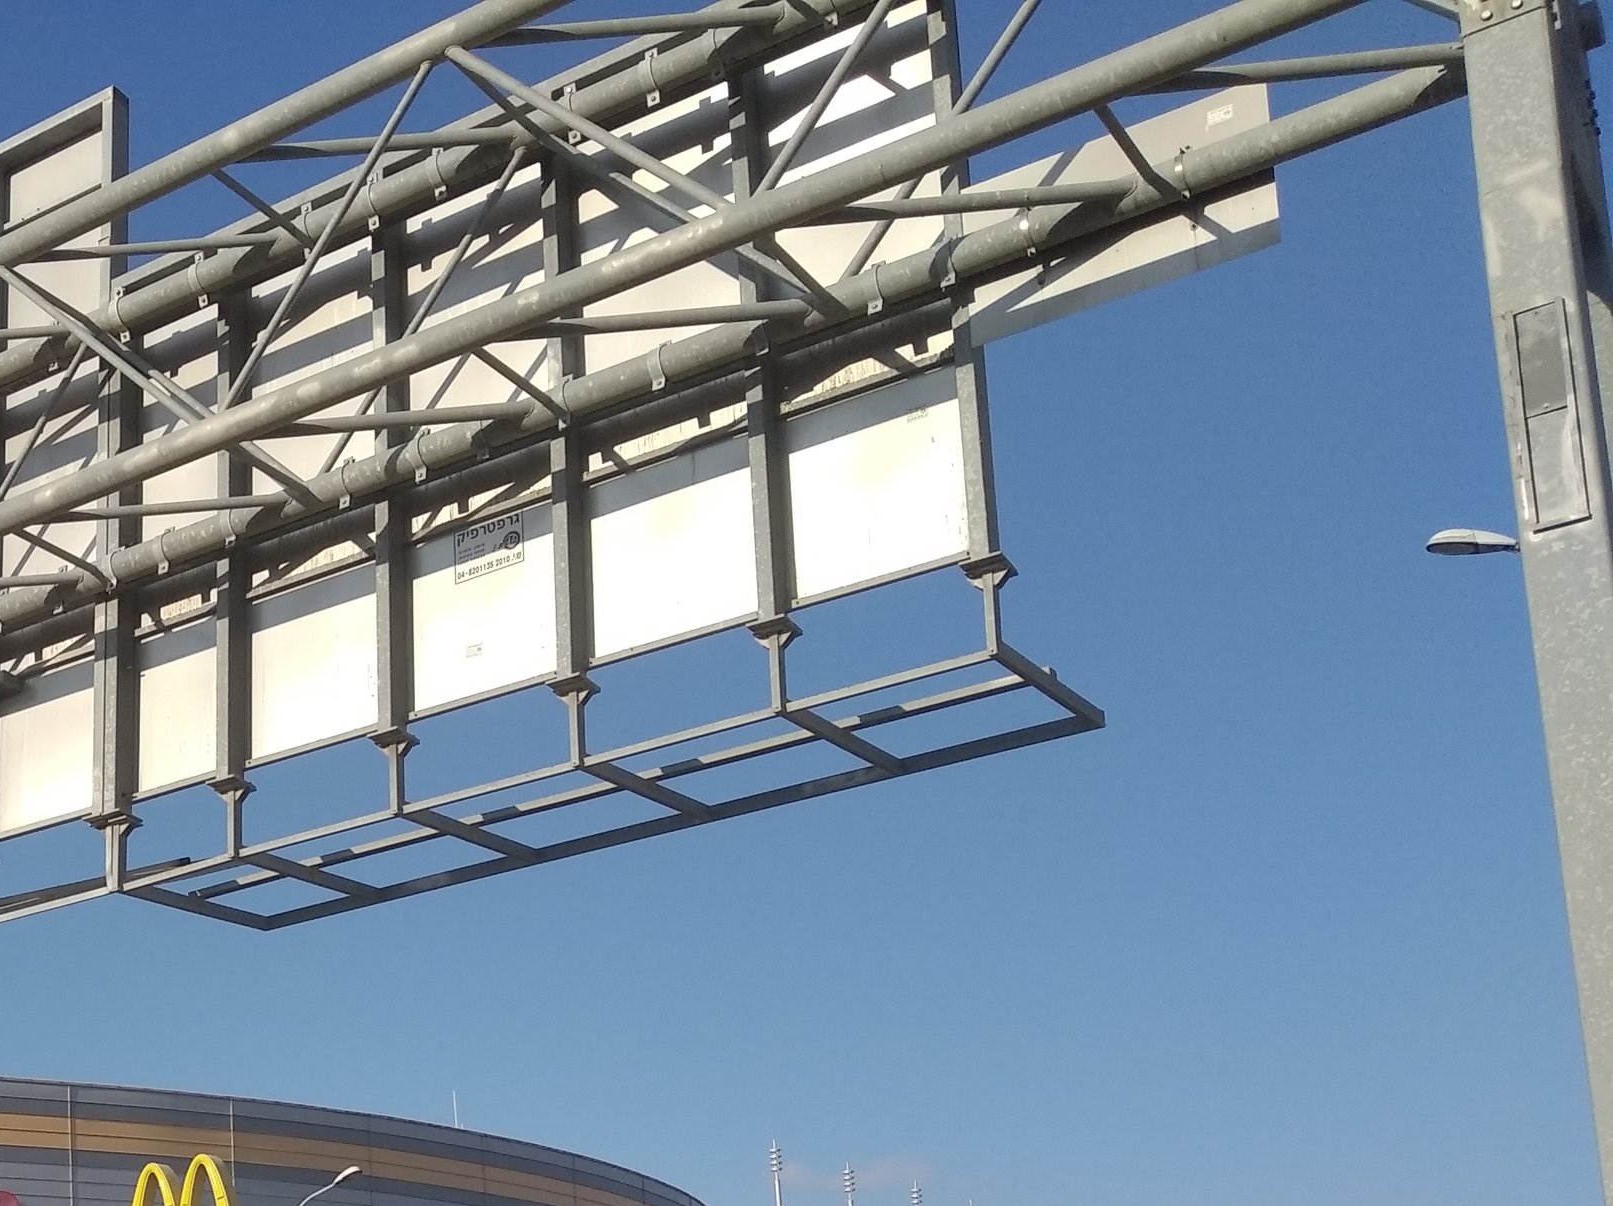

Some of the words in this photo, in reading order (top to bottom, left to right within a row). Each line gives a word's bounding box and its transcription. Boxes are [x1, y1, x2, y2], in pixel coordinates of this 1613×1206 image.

[456, 513, 520, 547] גרפטרפיק
[457, 561, 494, 580] 04-8201135
[495, 555, 511, 567] 2010
